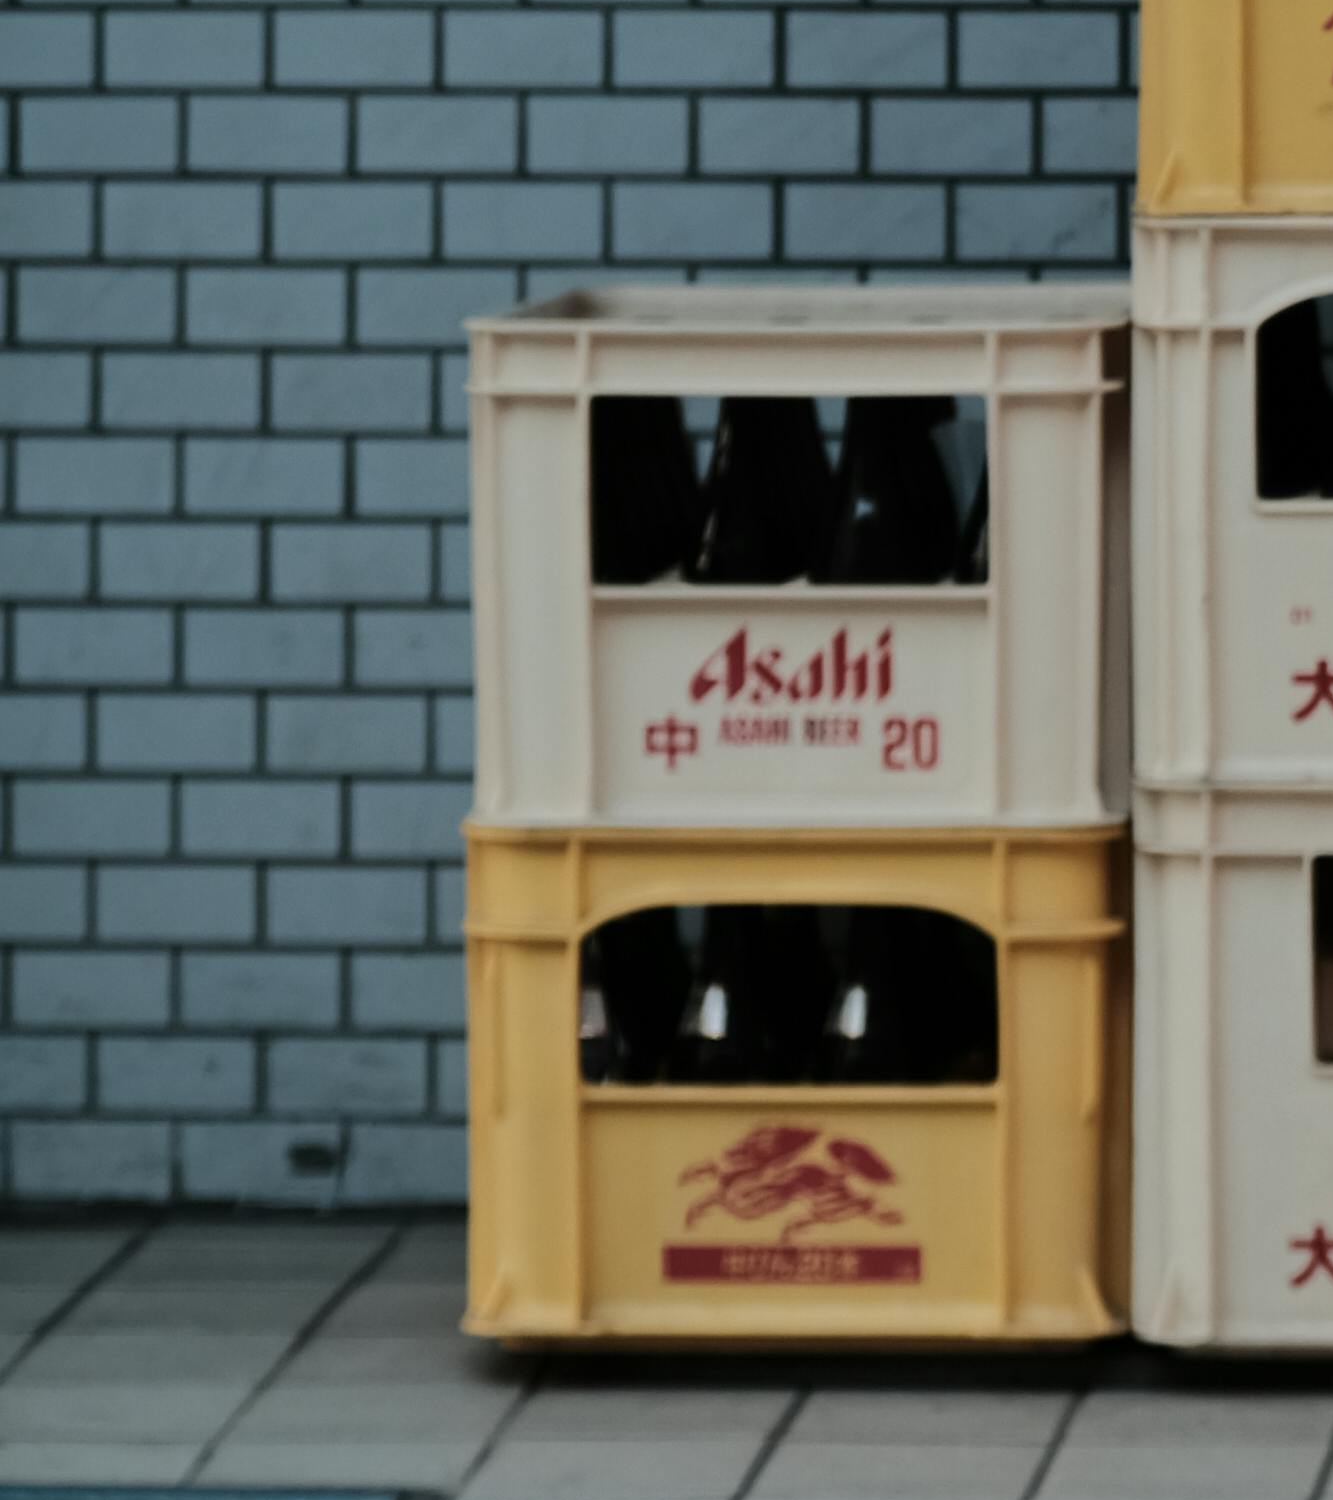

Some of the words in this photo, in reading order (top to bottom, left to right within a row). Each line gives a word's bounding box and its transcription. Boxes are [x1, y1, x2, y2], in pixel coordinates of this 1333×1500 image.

[688, 625, 893, 703] Asahi
[644, 714, 700, 771] 中
[720, 715, 790, 745] ASAHI
[803, 714, 860, 746] BEER
[881, 714, 939, 771] 20
